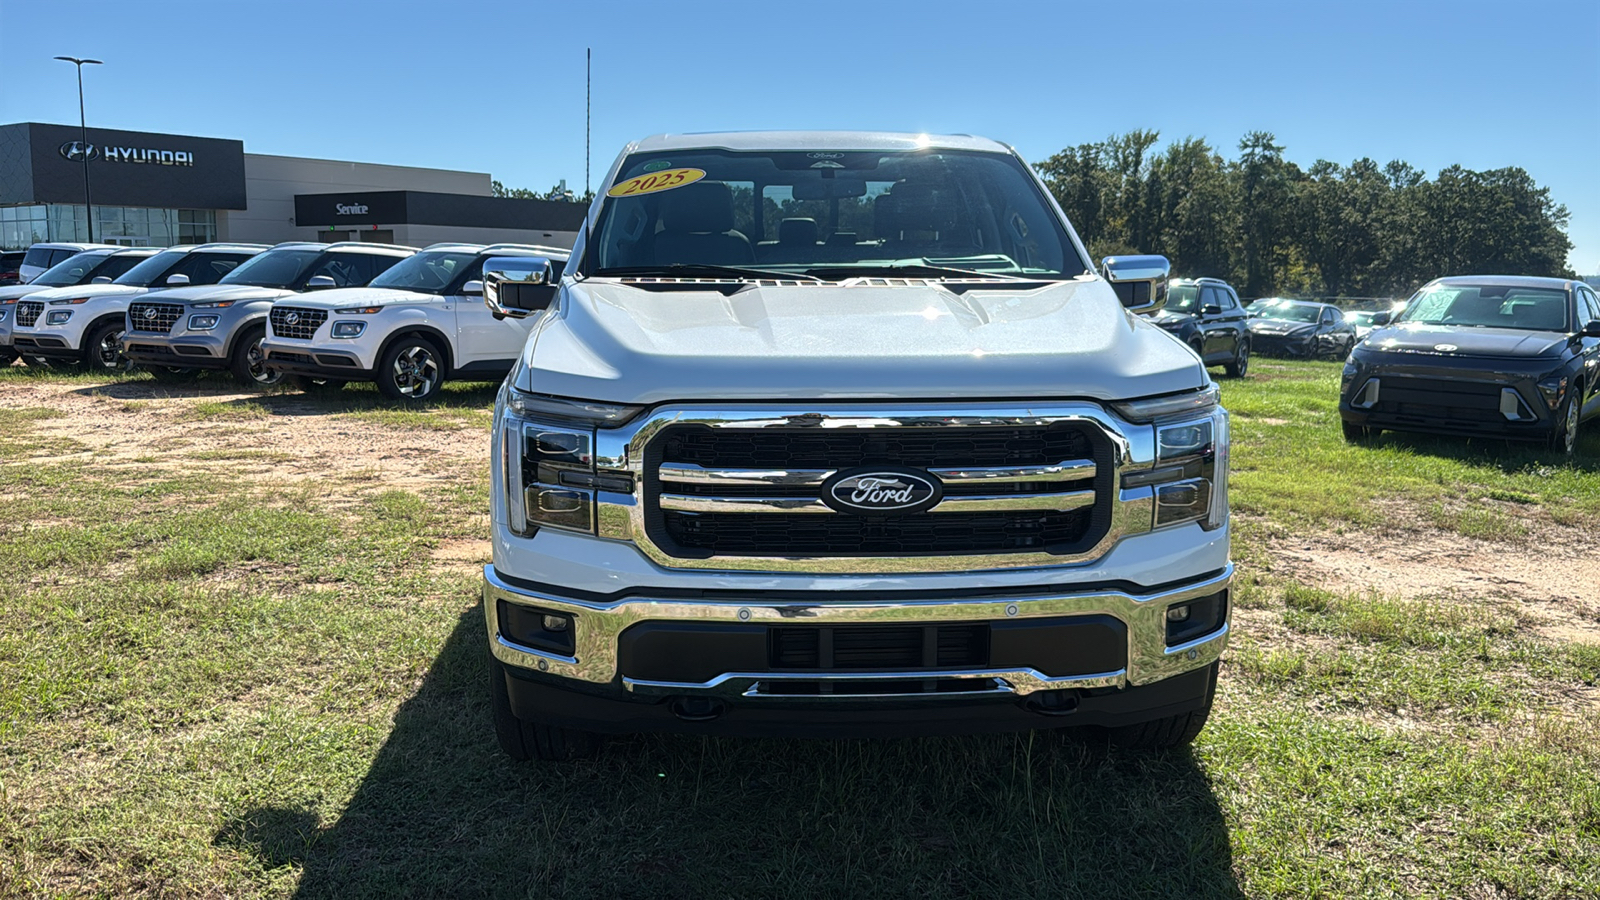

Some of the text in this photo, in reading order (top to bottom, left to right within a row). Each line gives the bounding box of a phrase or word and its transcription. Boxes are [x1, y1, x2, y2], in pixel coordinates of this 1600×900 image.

[104, 146, 193, 166] HYUNDAI
[622, 170, 690, 195] 2025
[336, 202, 369, 215] Service
[851, 477, 914, 503] Ford
